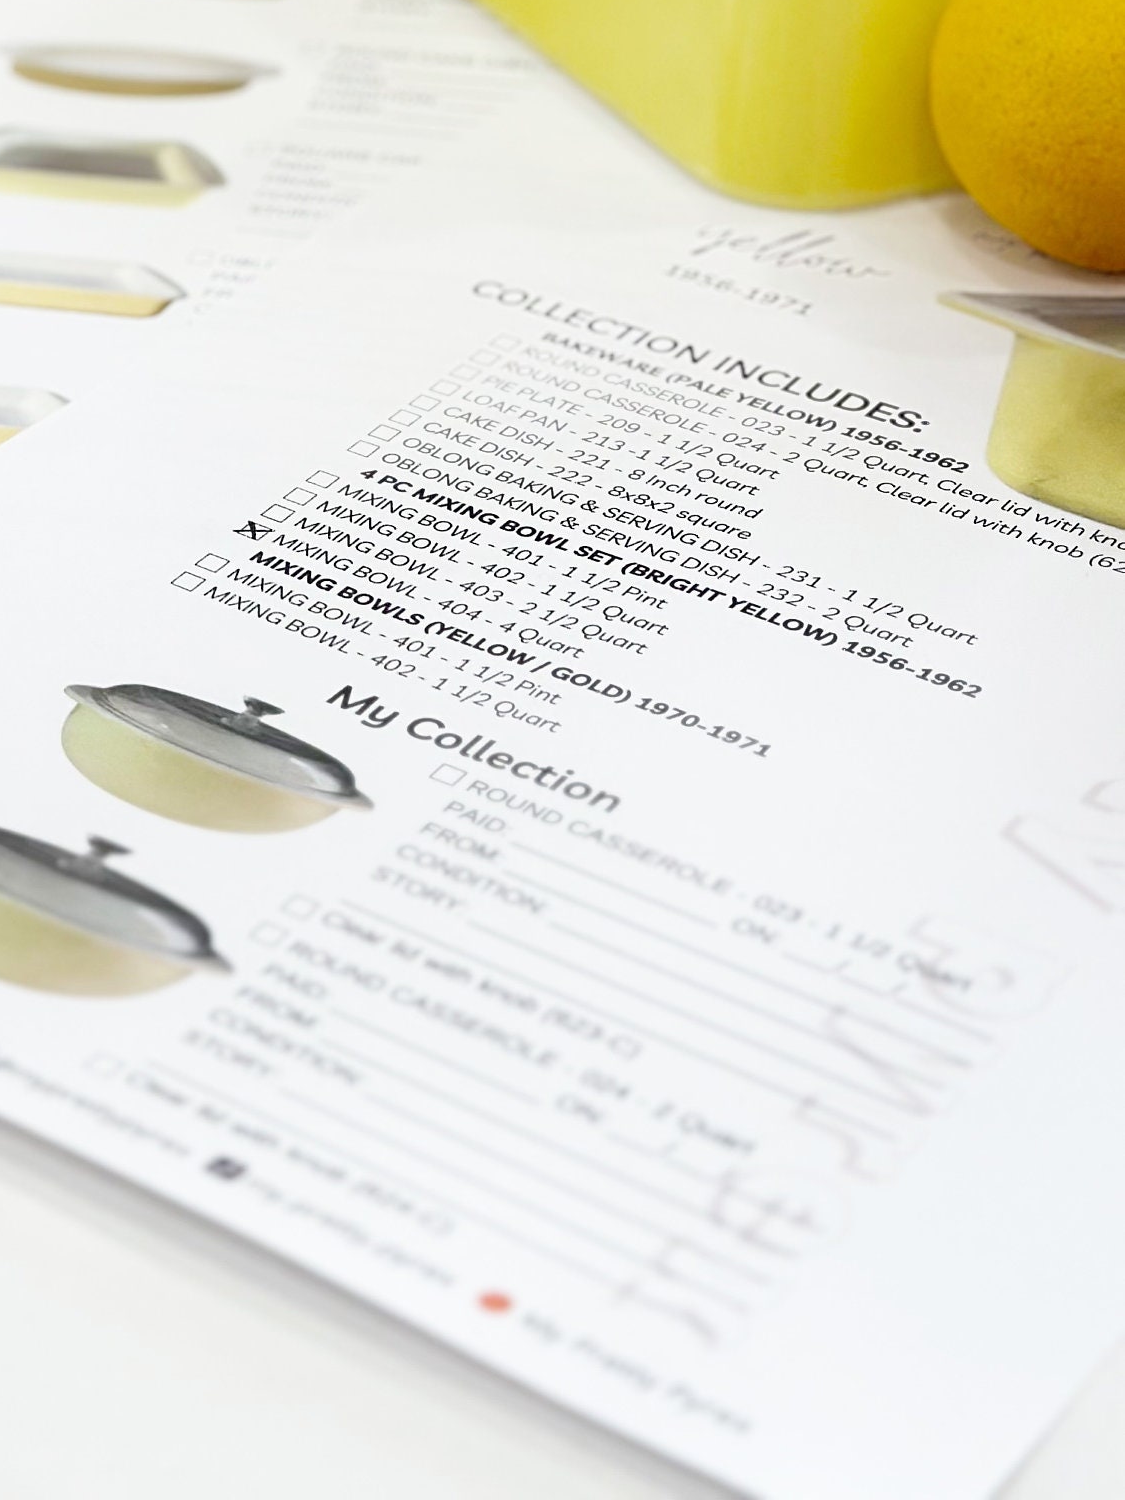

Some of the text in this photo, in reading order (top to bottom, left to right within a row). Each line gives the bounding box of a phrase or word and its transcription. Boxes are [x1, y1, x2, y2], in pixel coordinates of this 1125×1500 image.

[666, 264, 813, 317] 1956-1971
[692, 226, 891, 279] yellow
[472, 280, 929, 432] COLLECTION INCLUDES:
[541, 331, 969, 473] BAKEWARE (PALE YELLOW) 1956-1962
[422, 421, 751, 539] CAKE DISH 222 8x8x2 square
[442, 406, 763, 518] CAKE DISH 221 8 Inch round
[461, 390, 520, 414] LOAF
[517, 409, 568, 432] PAN
[581, 431, 626, 451] 213
[654, 455, 693, 473] 1/2
[695, 468, 759, 496] Quart
[480, 374, 779, 479] PIE PLATE 209 1 1/2 Quart
[583, 388, 707, 433] CASSEROLE
[722, 432, 766, 452] 024
[781, 451, 800, 463] 2
[875, 481, 937, 507] Clear
[938, 501, 970, 519] lid
[972, 515, 1022, 538] with
[1026, 531, 1083, 558] knob
[602, 373, 726, 417] CASSEROLE
[740, 416, 785, 436] 023
[801, 435, 817, 447] 1
[821, 442, 860, 460] 1/2
[936, 479, 998, 504] Clear
[1000, 498, 1032, 517] lid
[1034, 512, 1085, 536] with
[272, 533, 584, 658] MIXING BOWL 404 4 Quart
[293, 517, 647, 654] MIXING BOWL 403 2 1/2 Quart
[315, 500, 668, 635] MIXING BOWL 402 1 1/2 Quart
[337, 483, 667, 609] MIXING BOWL 401 1 1/2 Pint
[359, 469, 982, 698] 4 PC MIXING BOWL SET (BRIGHT YELLOW) 1956-1962
[381, 452, 913, 648] OBLONG BAKING & SERVING DISH 232 2 Quart
[402, 437, 977, 645] OBLONG BAKING & SERVING DISH 231 1 1/2 Quart
[203, 586, 561, 732] MIXING BOWL 402 1 1/2 Quart
[226, 568, 561, 705] MIXING BOWL 401 1 1/2 Pint
[249, 550, 337, 591] MIXING
[336, 585, 424, 625] BOWLS
[423, 620, 535, 665] (YELLOW
[550, 666, 631, 703] GOLD)
[635, 697, 770, 757] 1970-1971
[325, 683, 623, 815] My Collection
[466, 780, 564, 827] ROUND
[568, 820, 733, 896] CASSEROLE
